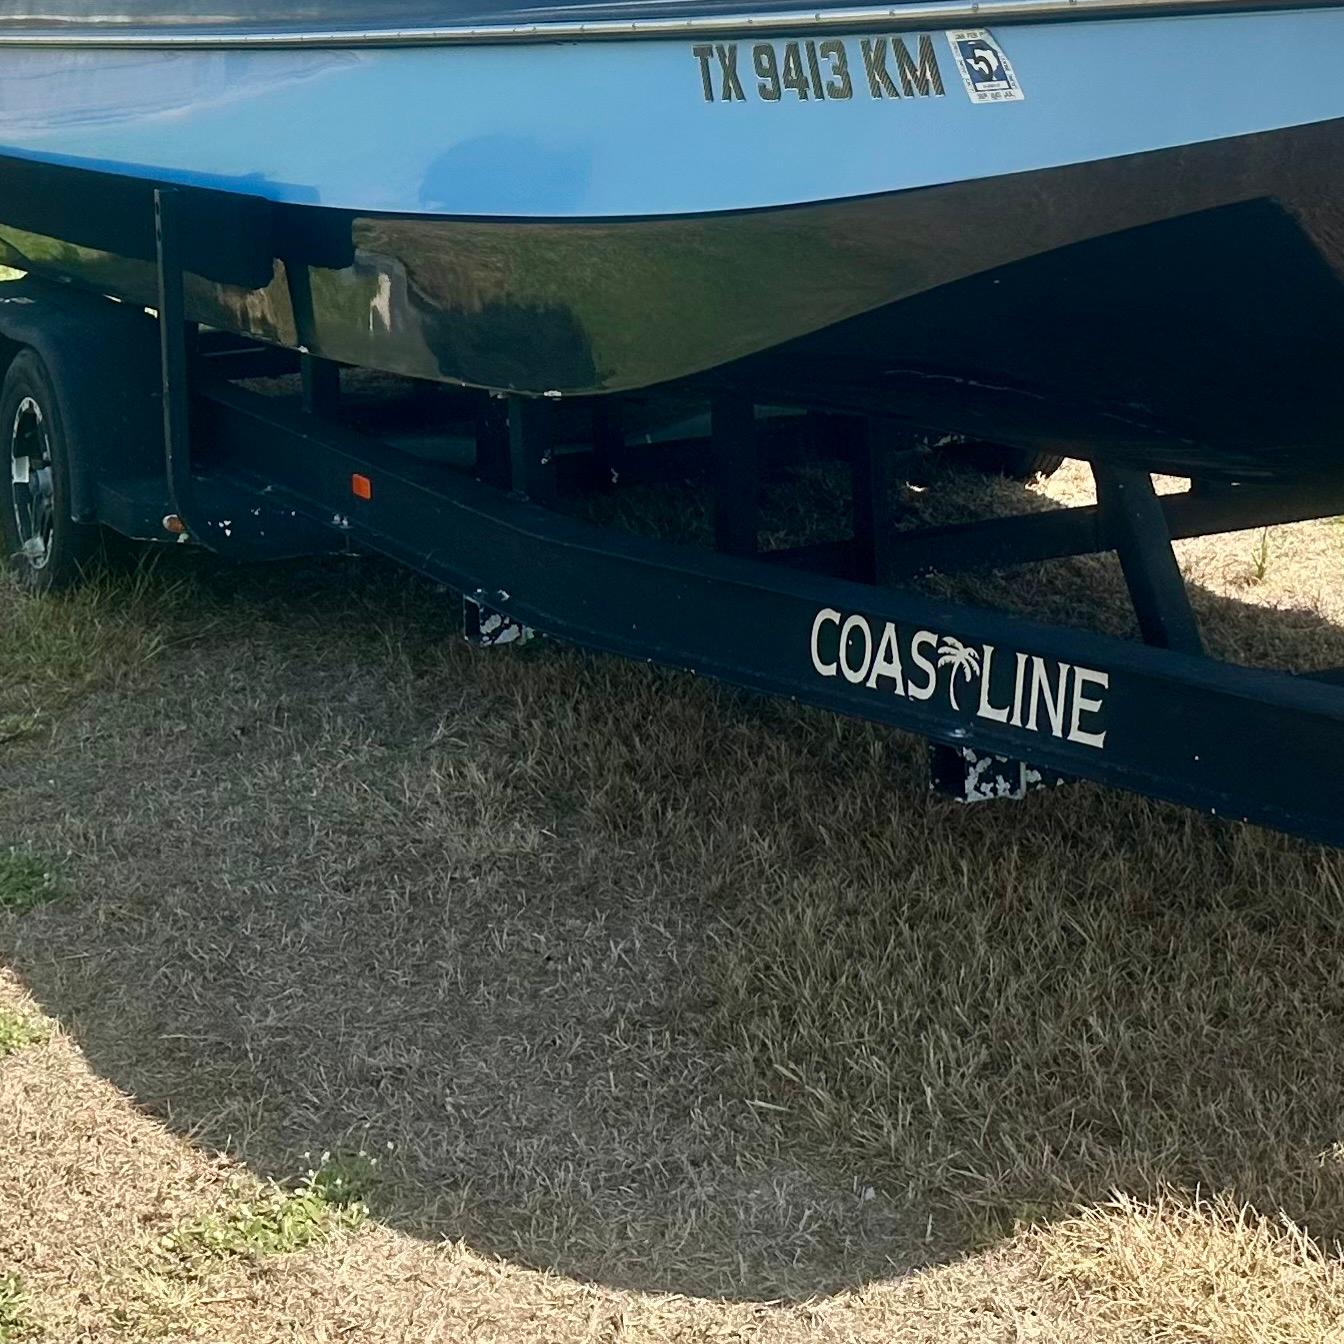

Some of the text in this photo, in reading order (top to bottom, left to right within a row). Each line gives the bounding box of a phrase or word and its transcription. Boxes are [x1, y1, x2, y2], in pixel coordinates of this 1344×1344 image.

[692, 44, 747, 103] TX
[752, 39, 854, 103] 9413
[859, 34, 946, 101] KM
